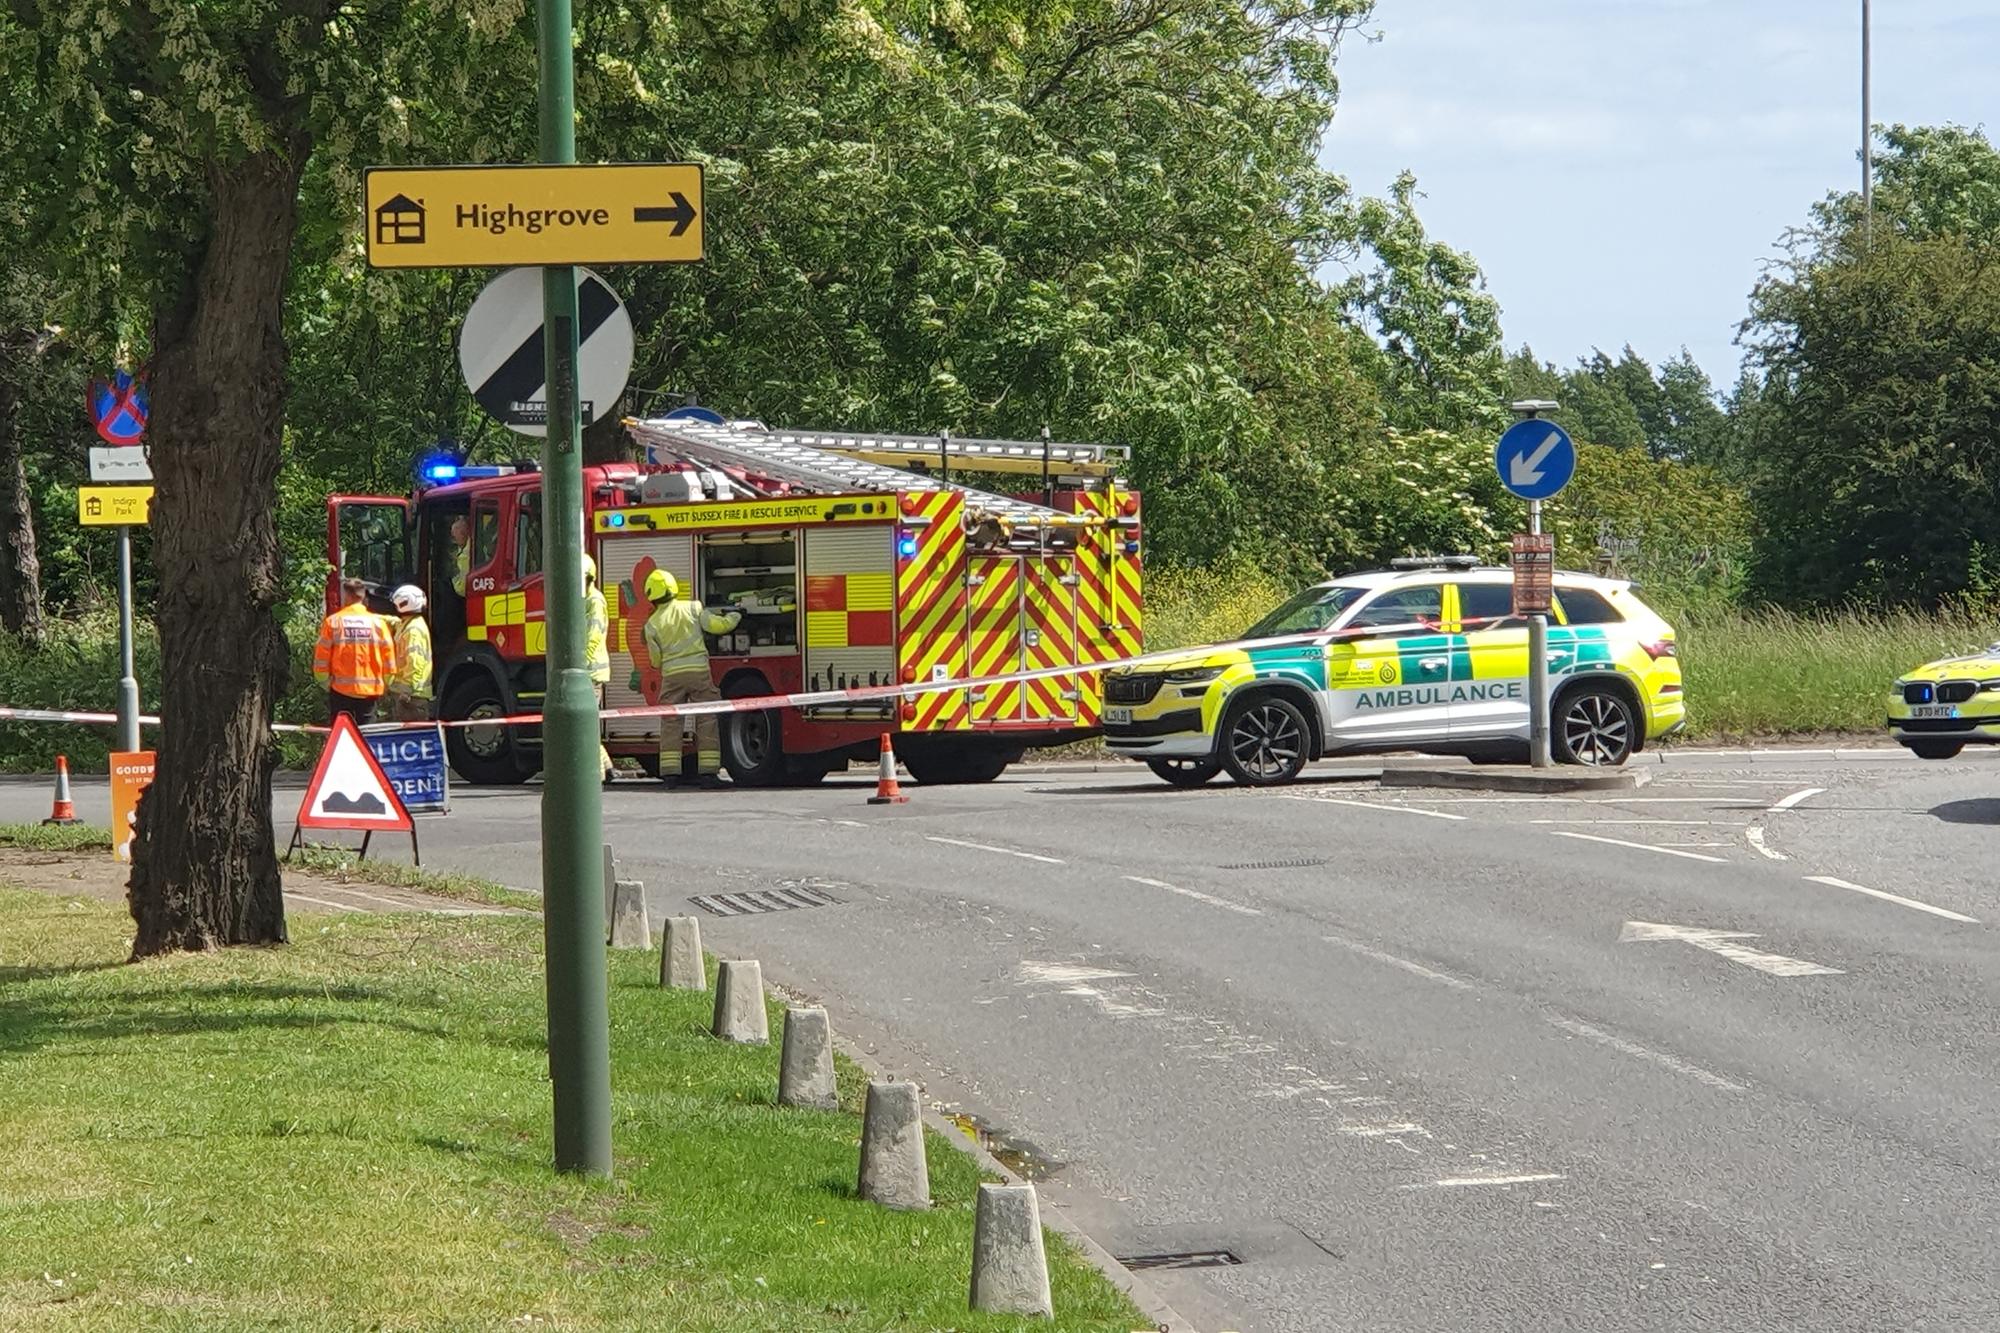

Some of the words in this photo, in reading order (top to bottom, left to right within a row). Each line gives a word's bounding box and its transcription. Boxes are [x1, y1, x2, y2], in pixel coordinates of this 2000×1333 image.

[456, 203, 609, 234] Highgrove
[113, 497, 137, 506] Indigo
[116, 507, 132, 515] Park
[666, 512, 690, 523] WEST
[692, 510, 721, 521] SUSSEX
[724, 509, 741, 519] FIRE
[743, 509, 748, 519] &
[750, 507, 782, 518] RESCUE
[784, 505, 817, 516] SERVICE
[473, 577, 495, 591] CAFS
[1355, 682, 1522, 709] AMBULANCE
[370, 740, 436, 763] LICE
[116, 765, 155, 775] GOODW
[391, 774, 443, 795] DENT
